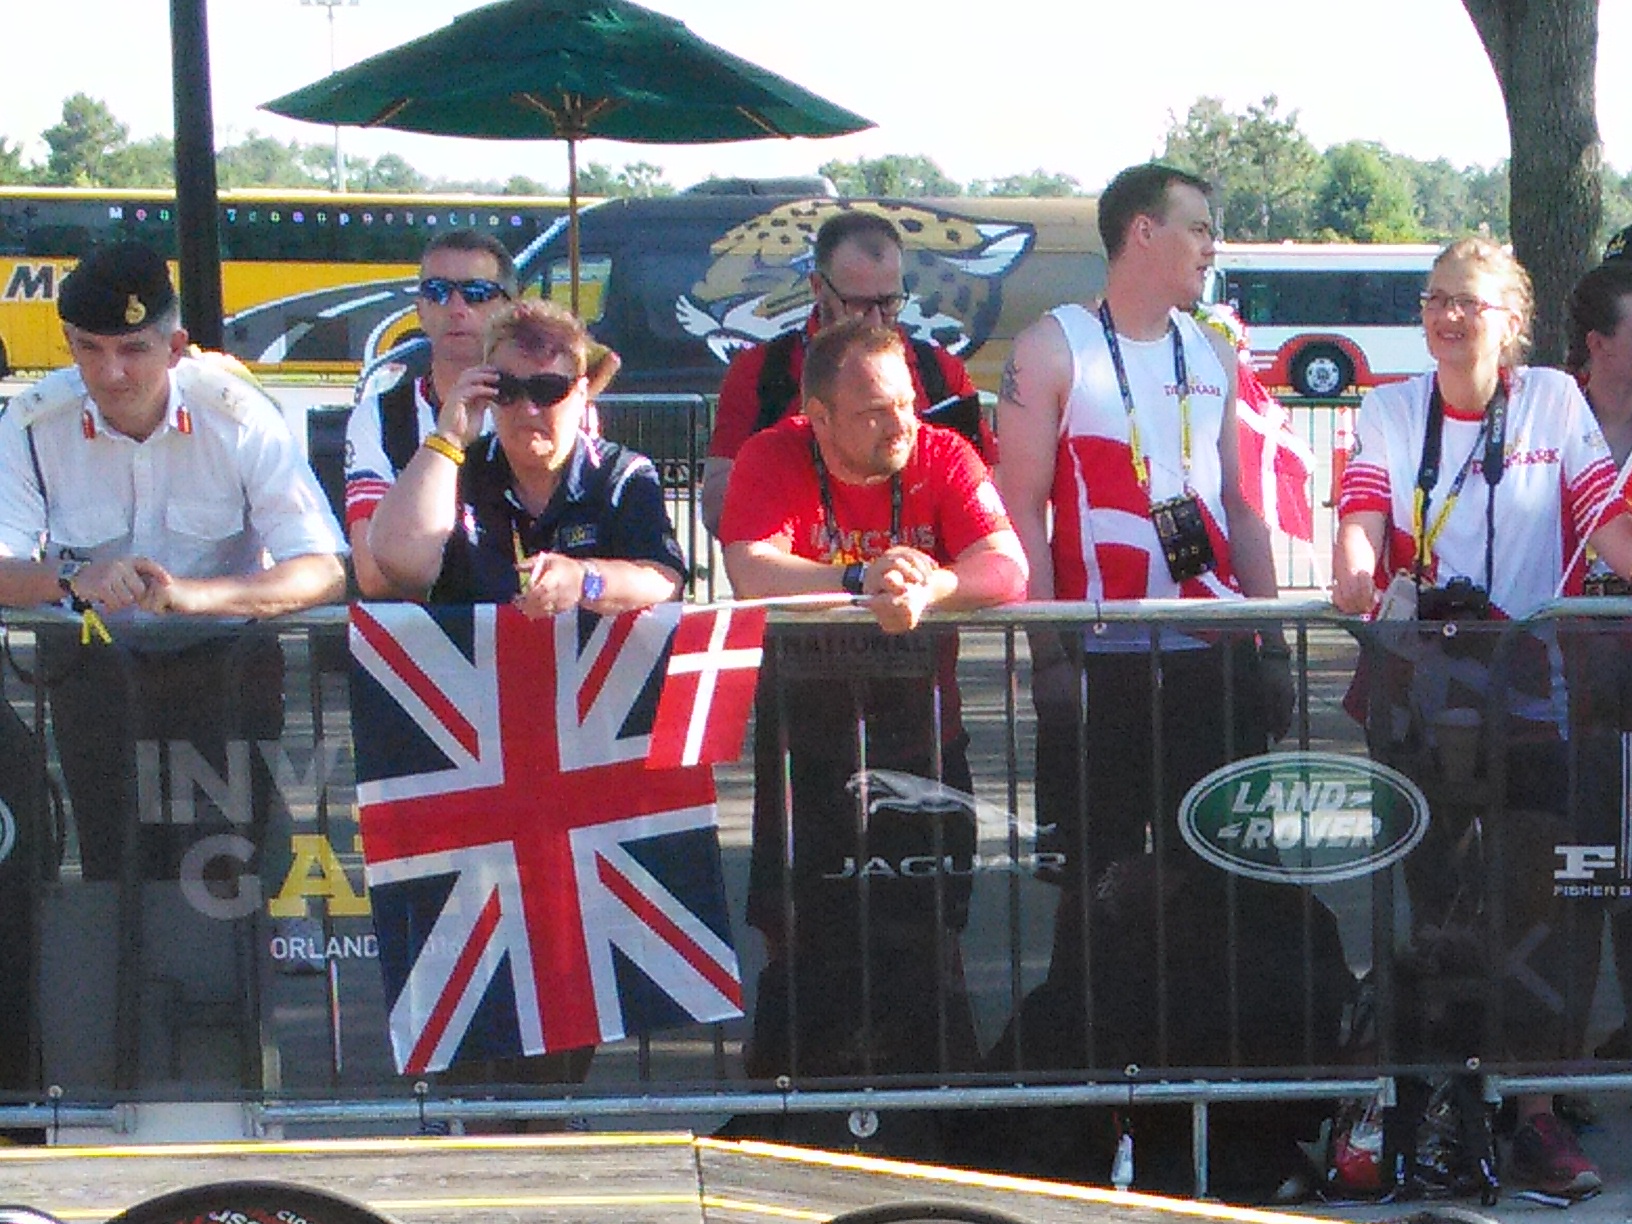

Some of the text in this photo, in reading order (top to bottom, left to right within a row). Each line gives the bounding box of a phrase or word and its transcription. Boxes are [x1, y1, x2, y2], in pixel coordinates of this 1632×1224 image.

[1232, 780, 1347, 813] LAND
[1241, 815, 1382, 849] ROVER
[822, 852, 1068, 880] JAGUAR
[1552, 884, 1616, 897] FISHER
[269, 934, 380, 960] ORLAND
